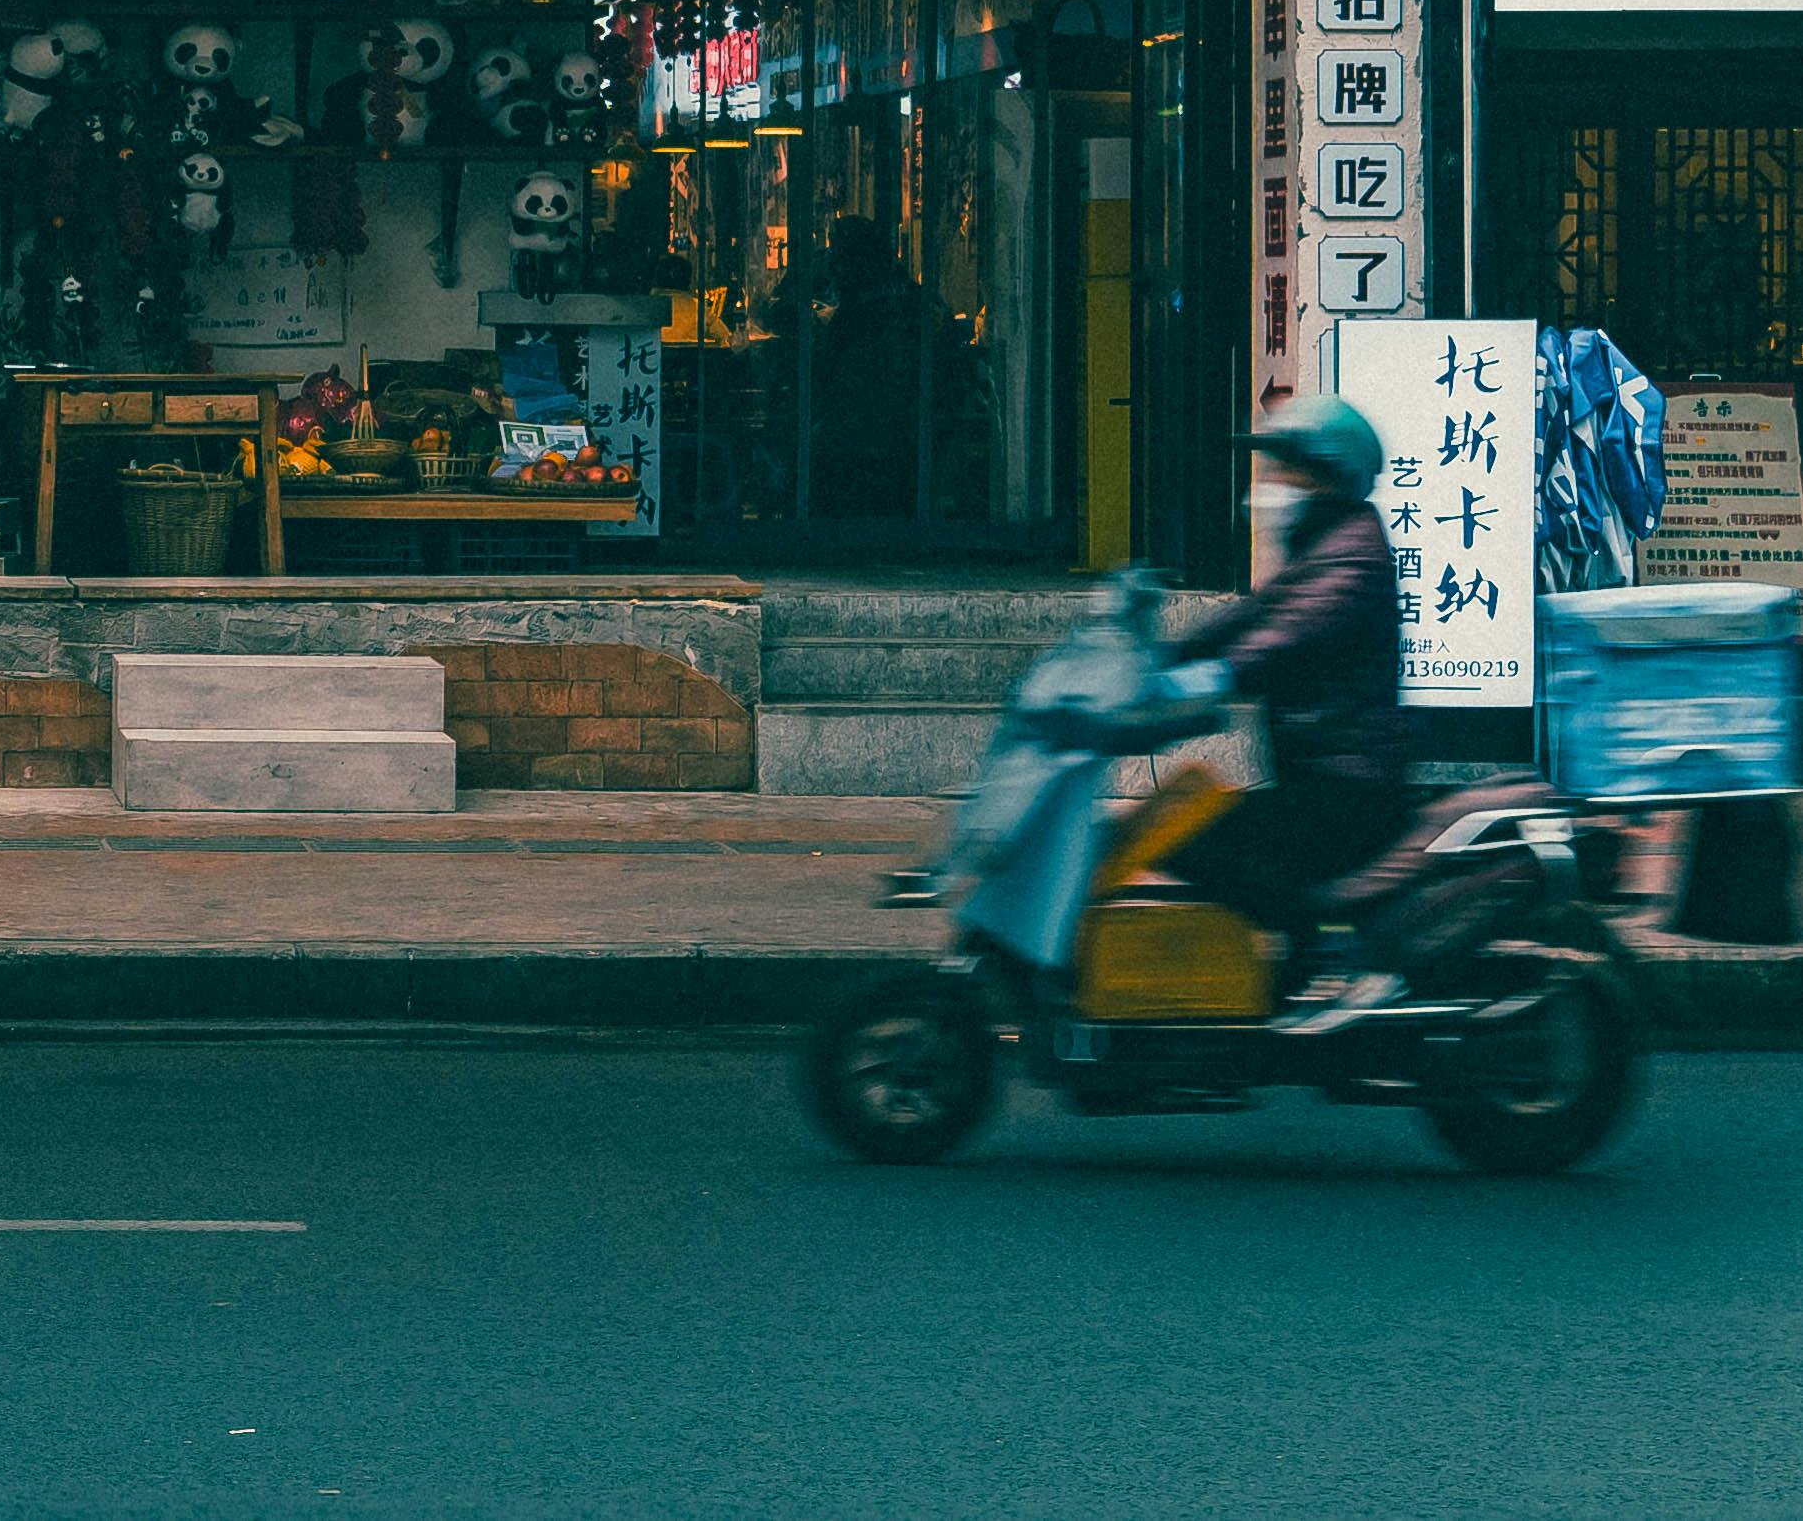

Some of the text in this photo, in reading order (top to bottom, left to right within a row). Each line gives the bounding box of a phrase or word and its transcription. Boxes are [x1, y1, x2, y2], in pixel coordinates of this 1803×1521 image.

[1390, 456, 1423, 625] 艺术酒店
[1434, 335, 1504, 624] 托斯卡纳
